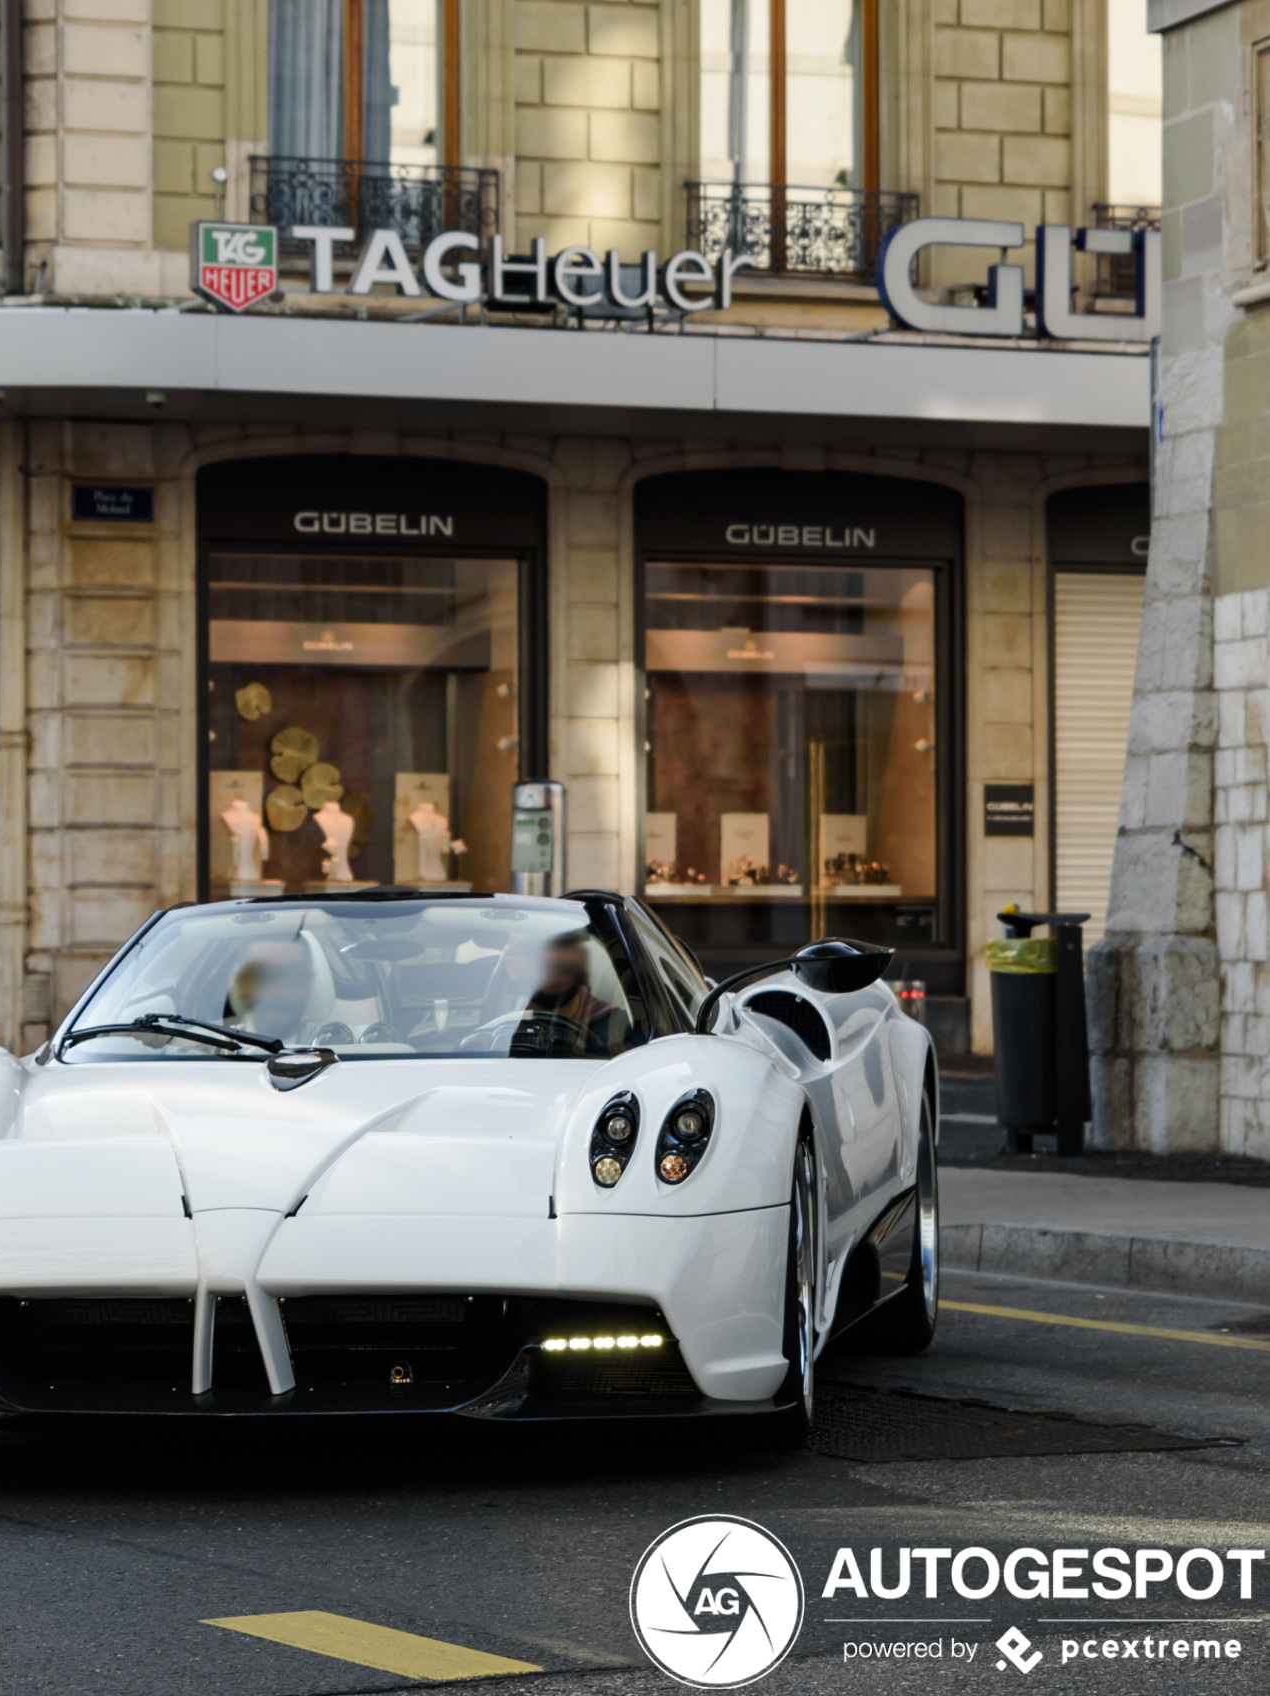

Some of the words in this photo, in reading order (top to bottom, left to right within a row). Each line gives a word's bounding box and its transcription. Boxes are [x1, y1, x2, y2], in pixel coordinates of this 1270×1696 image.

[211, 229, 266, 265] TAG
[290, 225, 480, 300] TAG
[490, 233, 757, 312] Heuer
[204, 269, 271, 304] HEUER
[293, 511, 454, 537] GÜBELIN
[725, 524, 875, 548] GÜBELIN
